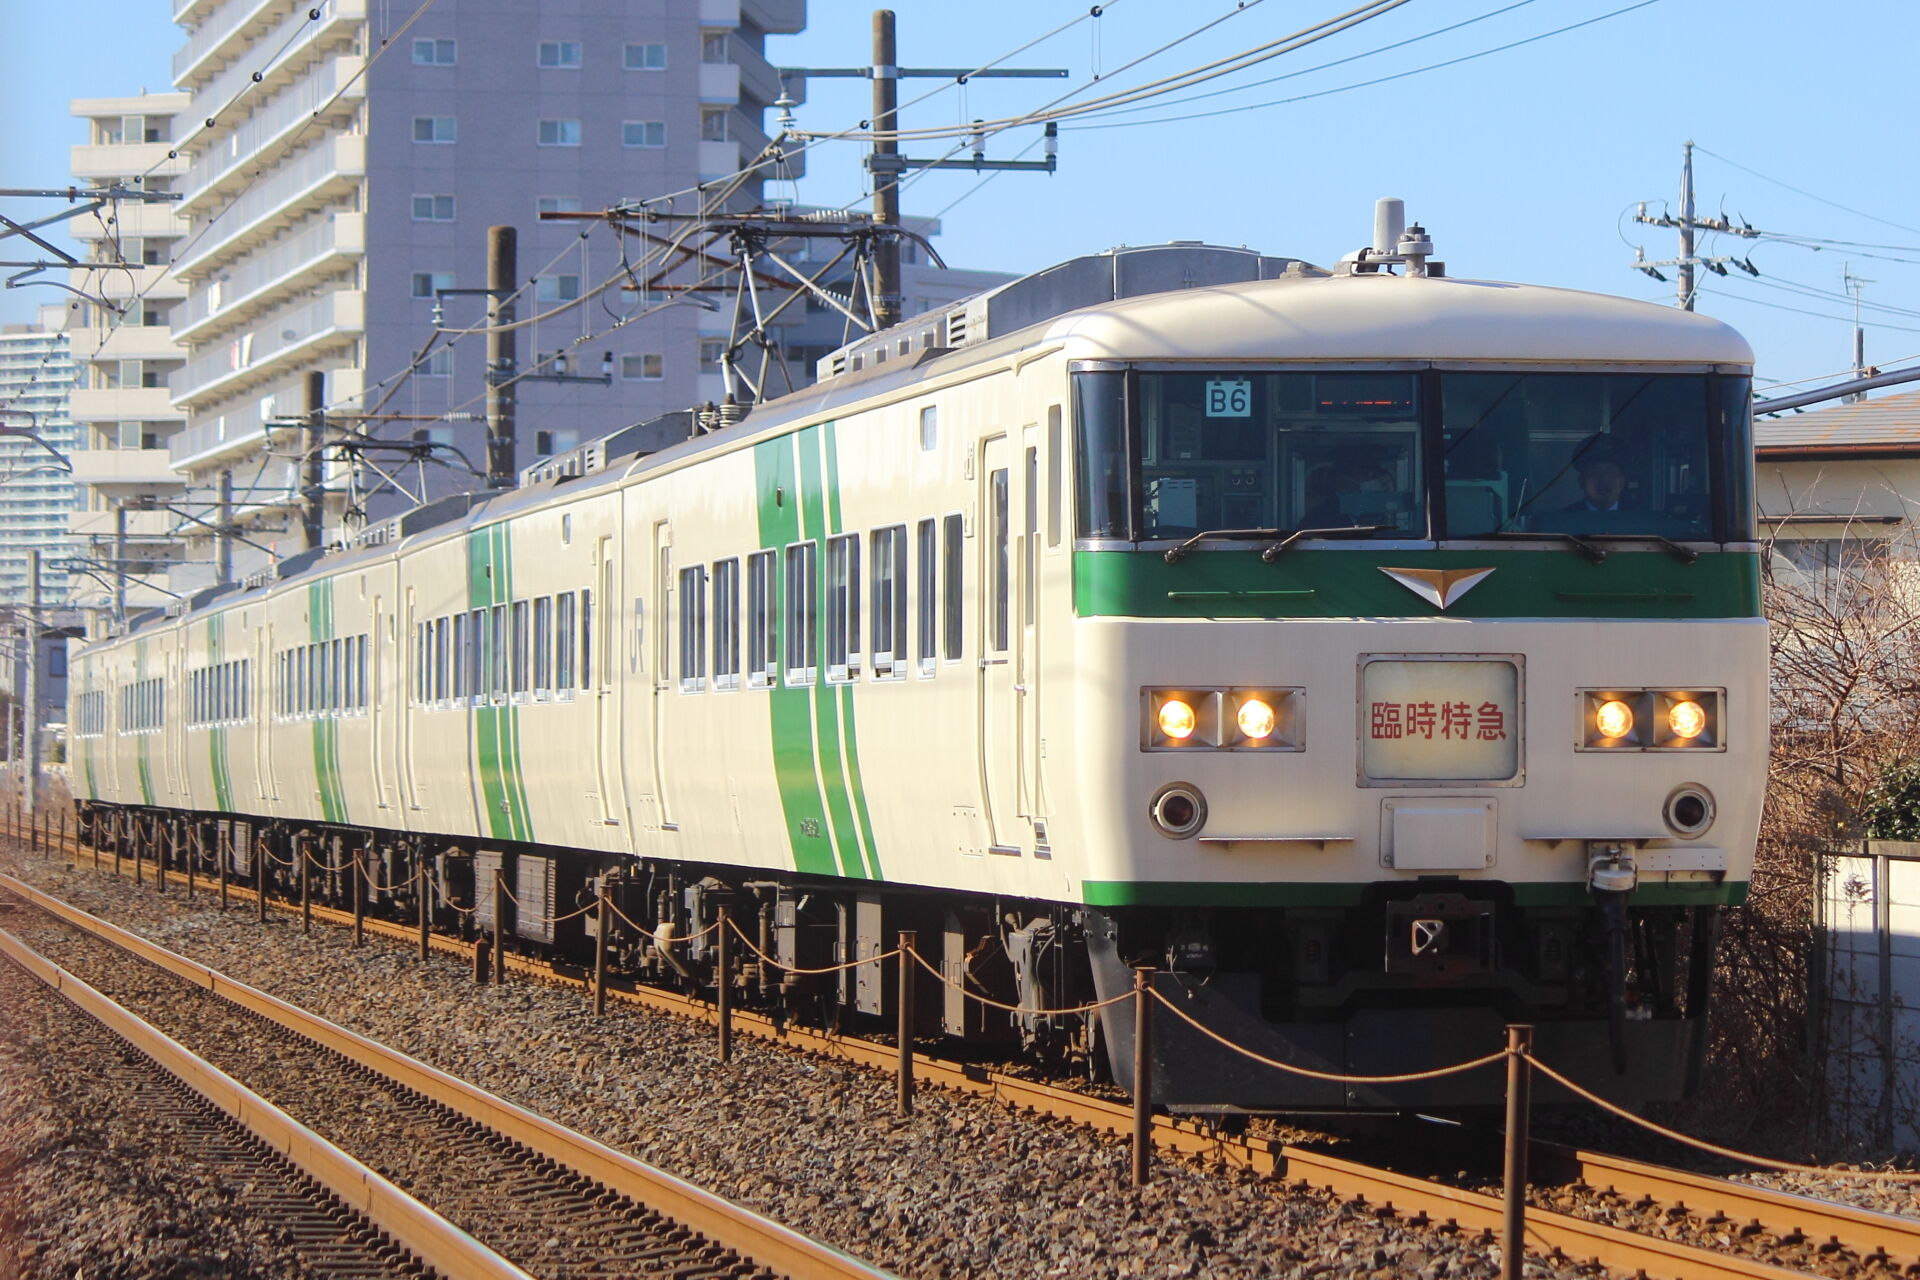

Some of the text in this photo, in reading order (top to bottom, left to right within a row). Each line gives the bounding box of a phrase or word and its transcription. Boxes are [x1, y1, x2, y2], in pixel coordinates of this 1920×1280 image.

[1210, 388, 1246, 413] B6
[1371, 701, 1507, 741] 臨時特急
